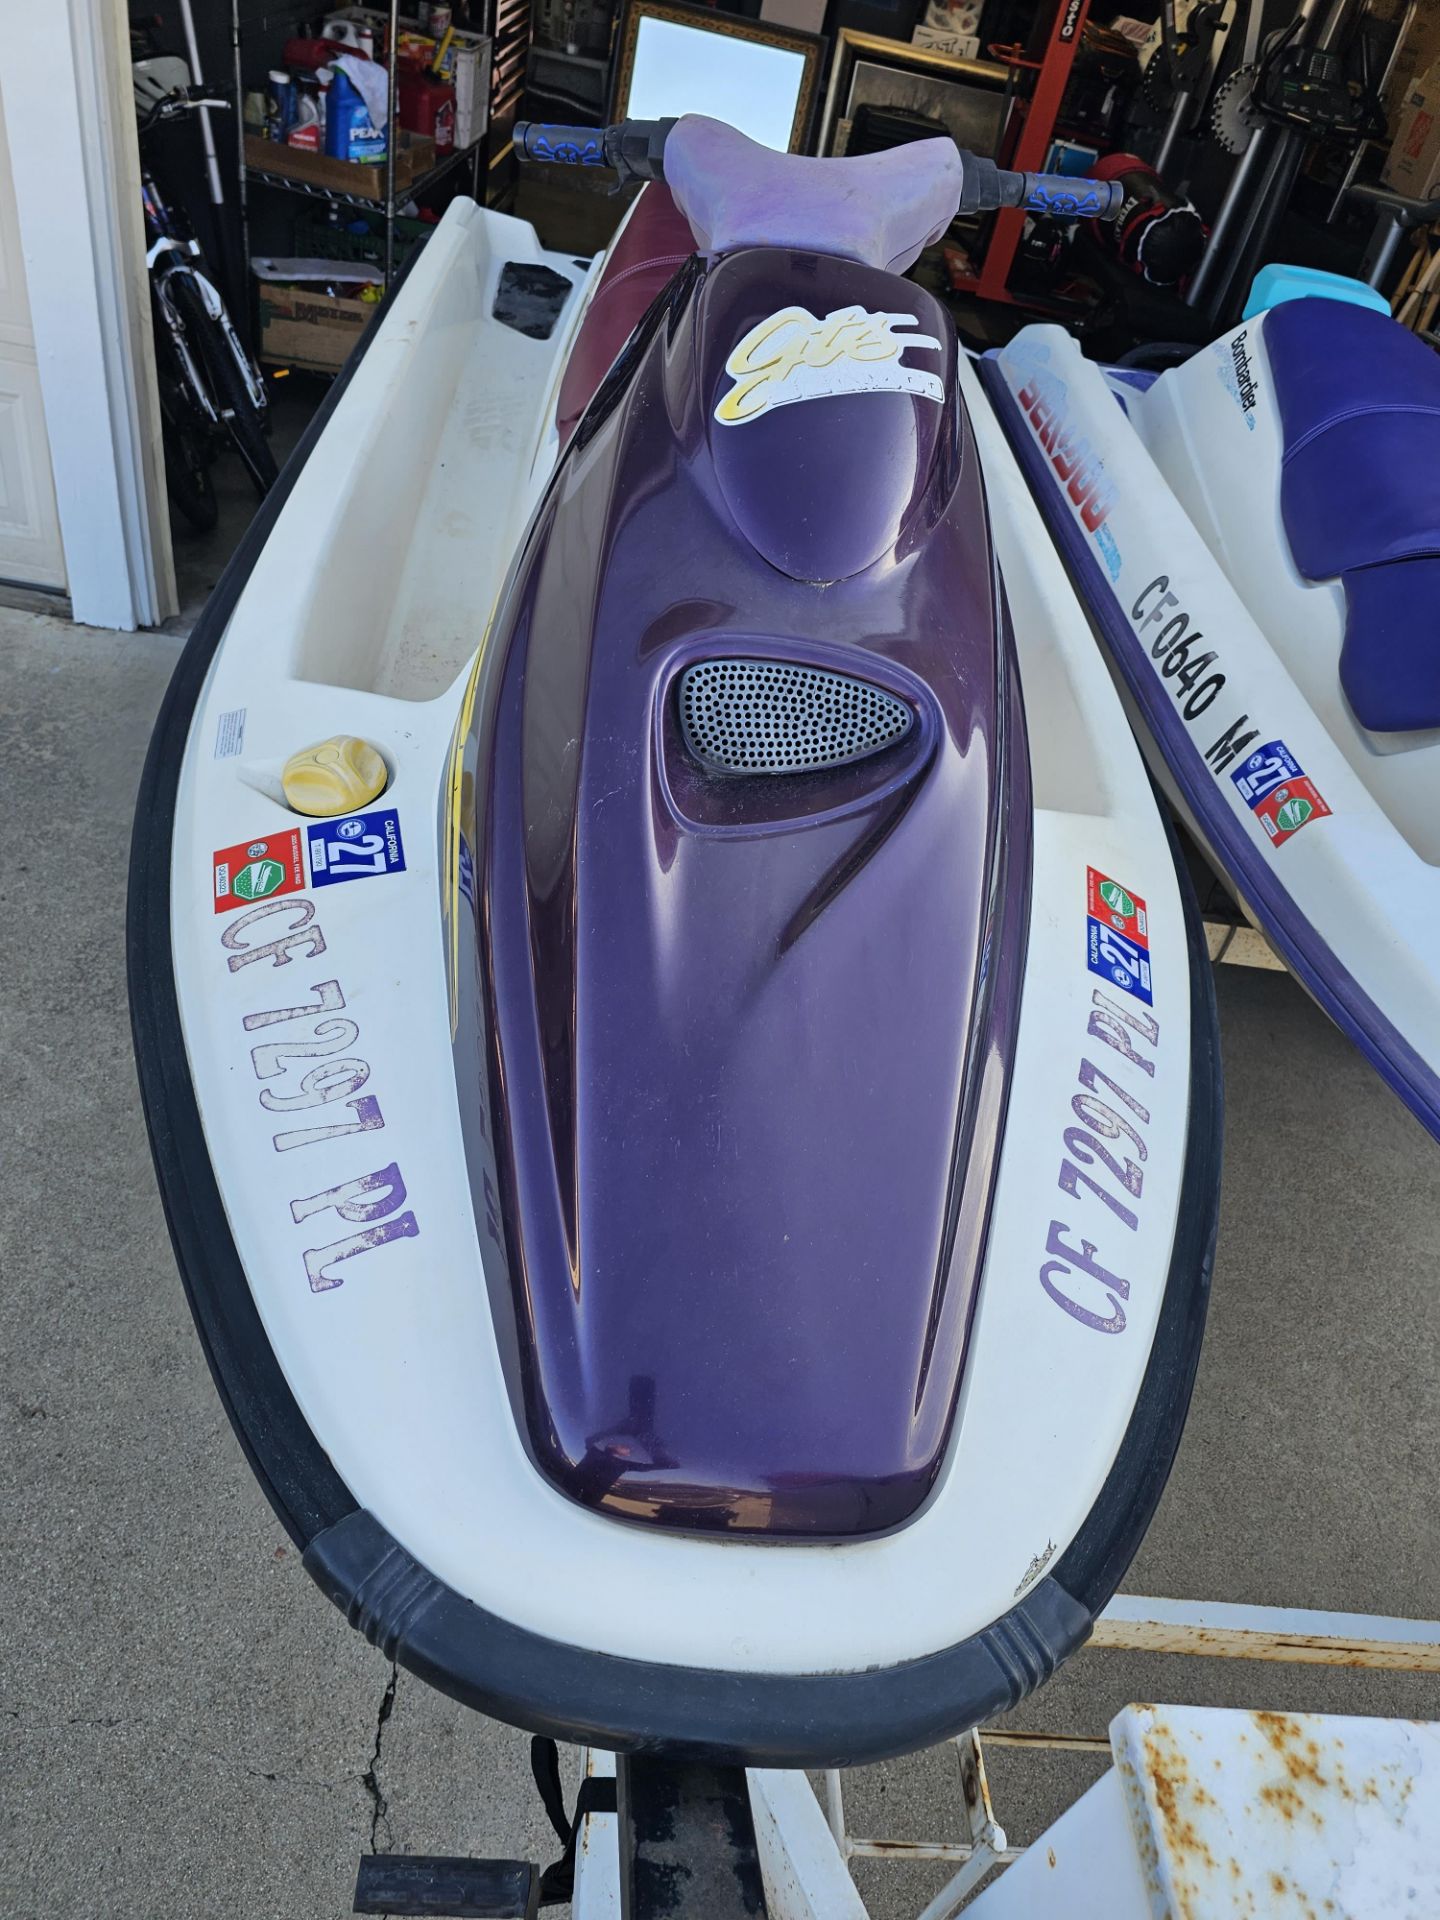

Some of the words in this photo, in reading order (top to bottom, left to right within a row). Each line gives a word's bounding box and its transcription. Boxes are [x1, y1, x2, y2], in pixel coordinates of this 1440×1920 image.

[1231, 329, 1258, 413] Bombardier
[1204, 714, 1261, 776] M
[1246, 757, 1292, 796] 27
[327, 834, 387, 874] 27
[384, 820, 400, 864] CALIFORNIA
[221, 898, 327, 973] CF
[1090, 925, 1099, 965] CALIFORNIA
[1100, 923, 1140, 979] 27
[242, 979, 385, 1152] 7297
[1086, 988, 1160, 1078] PL
[1058, 1057, 1150, 1232] 7297
[290, 1161, 420, 1293] PL
[1039, 1219, 1131, 1335] CF
